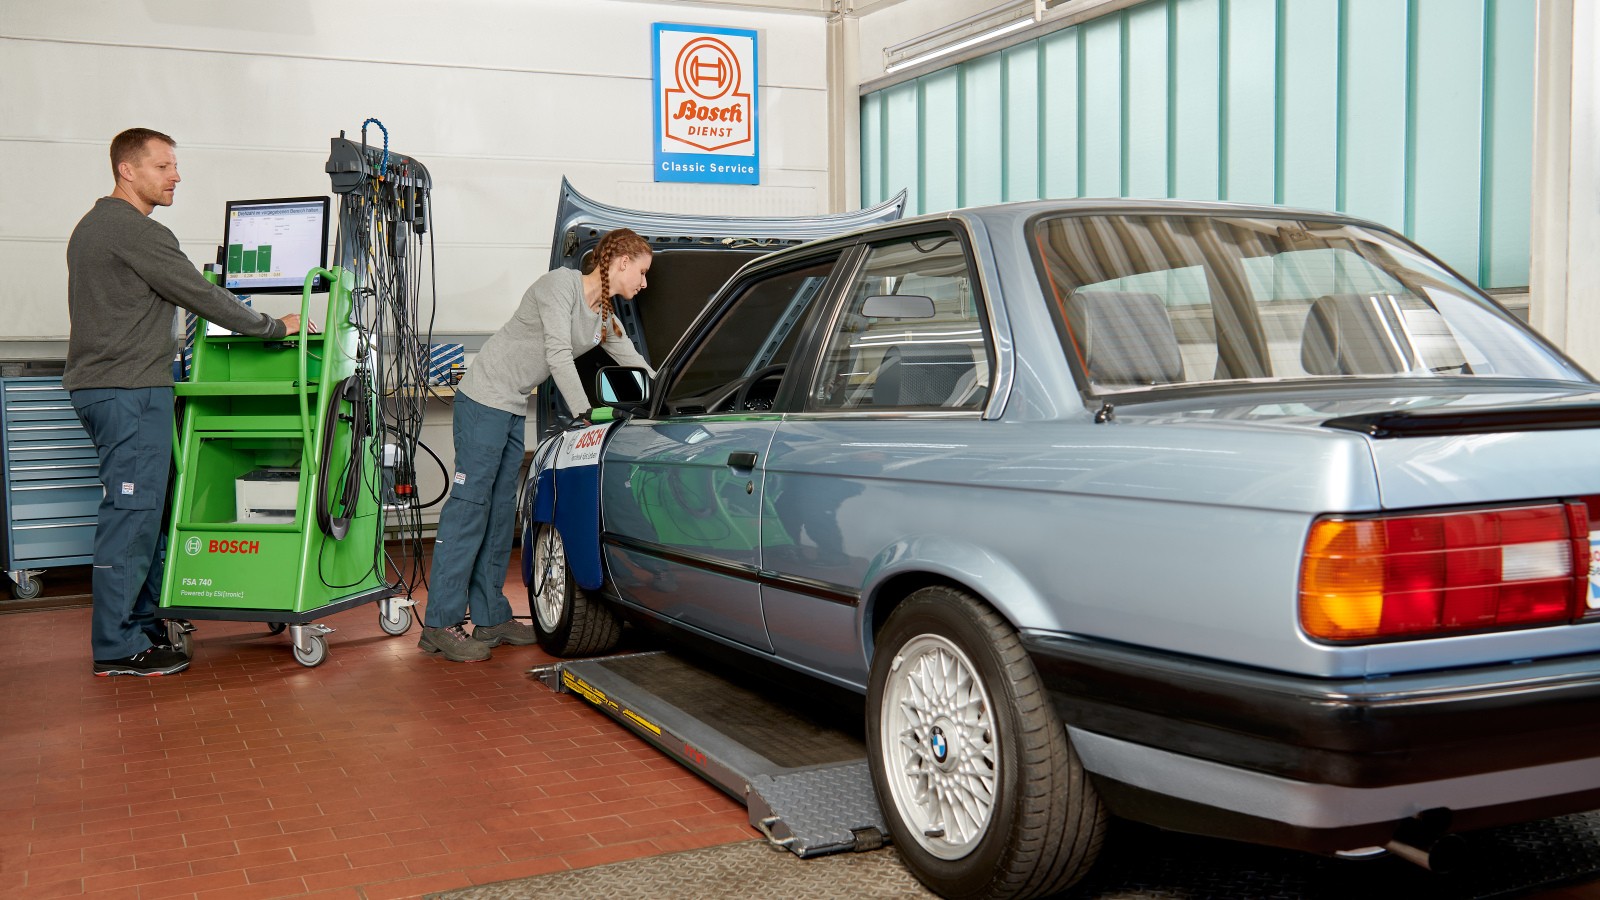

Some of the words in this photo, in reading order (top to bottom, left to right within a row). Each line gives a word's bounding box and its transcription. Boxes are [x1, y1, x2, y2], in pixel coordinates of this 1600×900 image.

[673, 99, 742, 123] Bosch
[687, 126, 733, 137] DIENST
[662, 162, 705, 172] Classic
[710, 163, 754, 174] Service
[575, 427, 606, 449] BOSCH
[208, 539, 260, 554] BOSCH
[182, 578, 197, 586] FSA
[199, 578, 212, 586] 740
